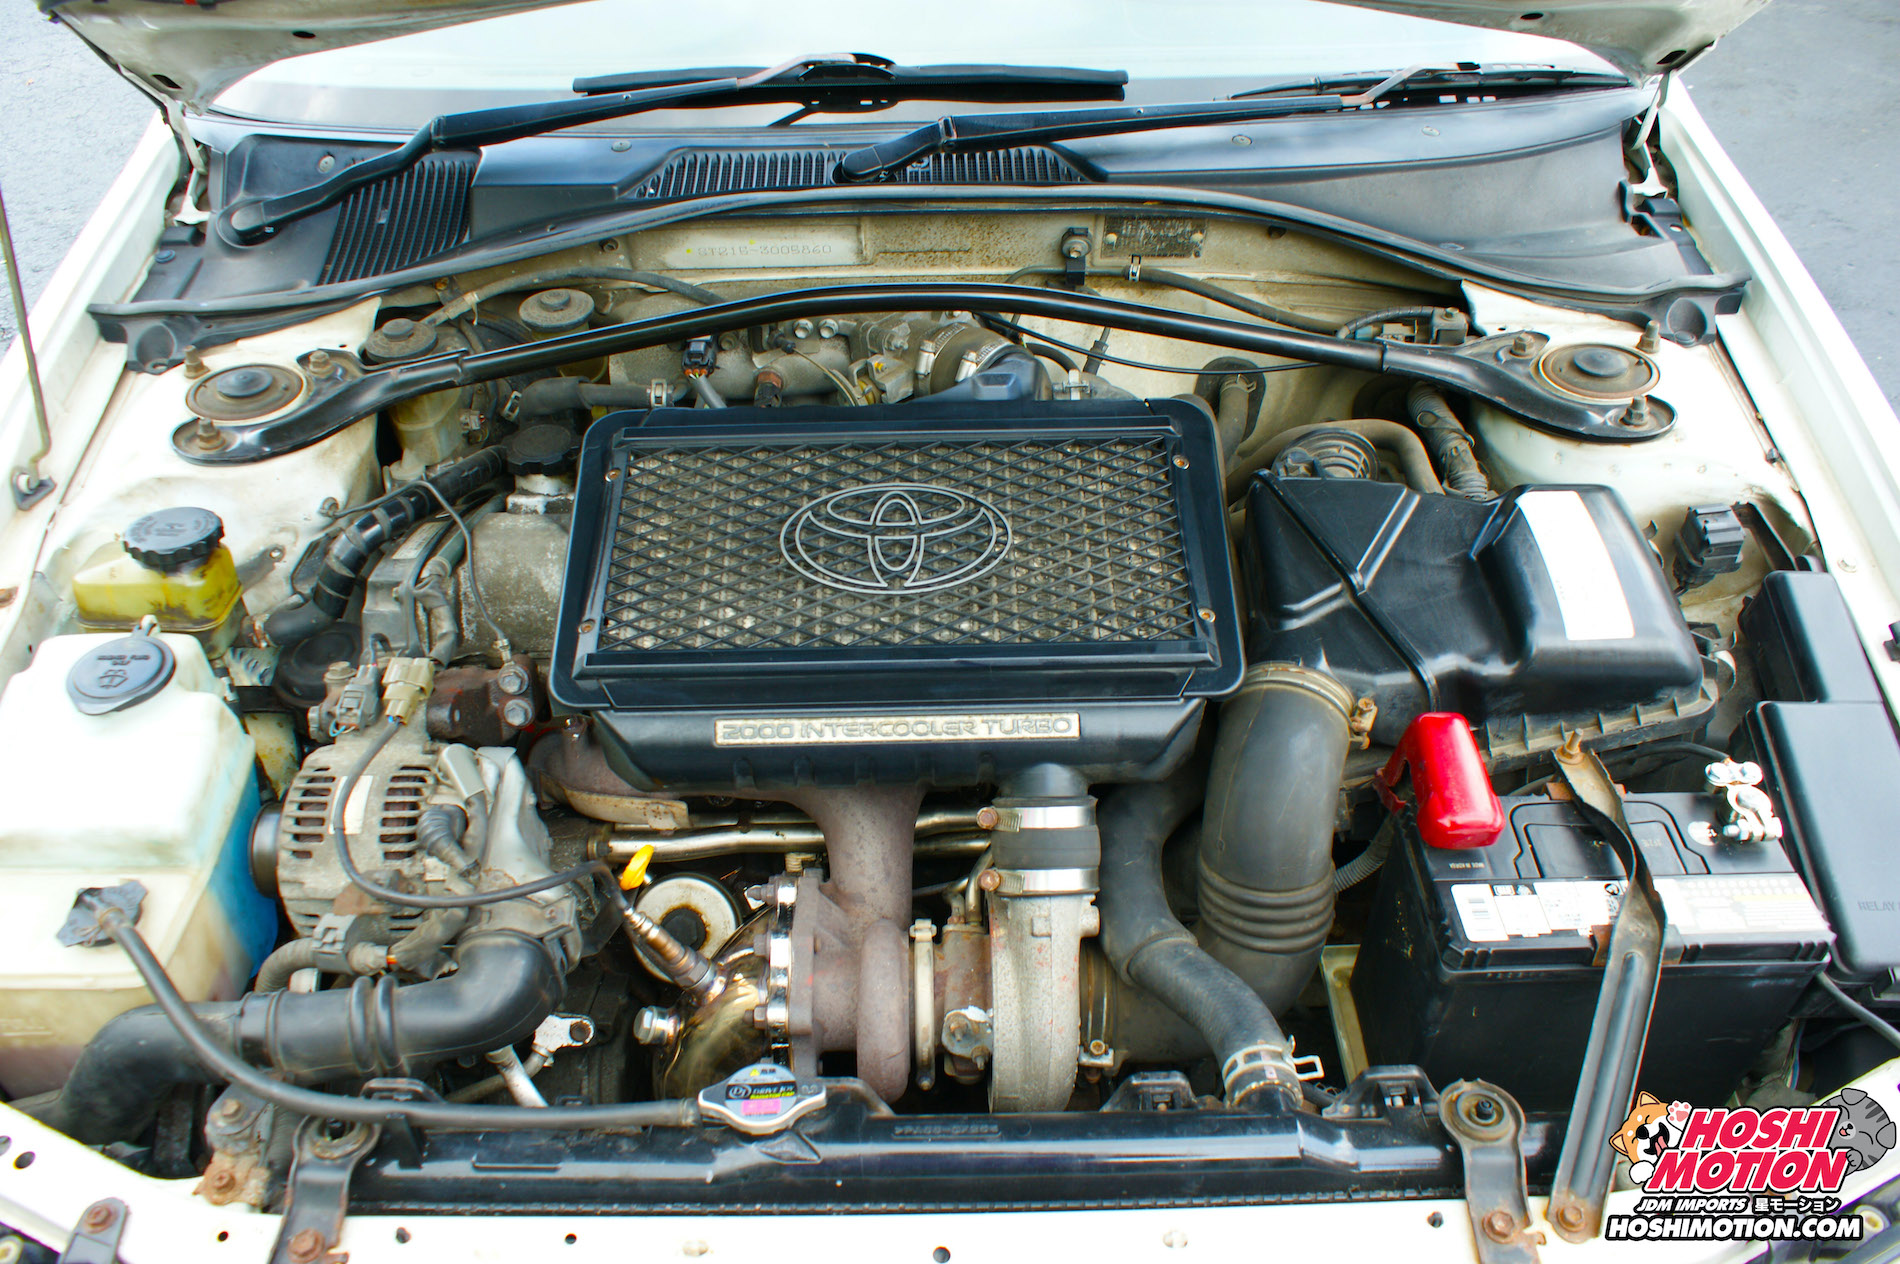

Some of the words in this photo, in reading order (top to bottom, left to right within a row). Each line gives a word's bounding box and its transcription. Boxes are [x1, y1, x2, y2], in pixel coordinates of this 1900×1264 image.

[722, 724, 795, 740] 2000
[800, 719, 978, 739] INTERCOOLER
[983, 717, 1073, 736] TURBO
[1857, 900, 1895, 911] RELAY
